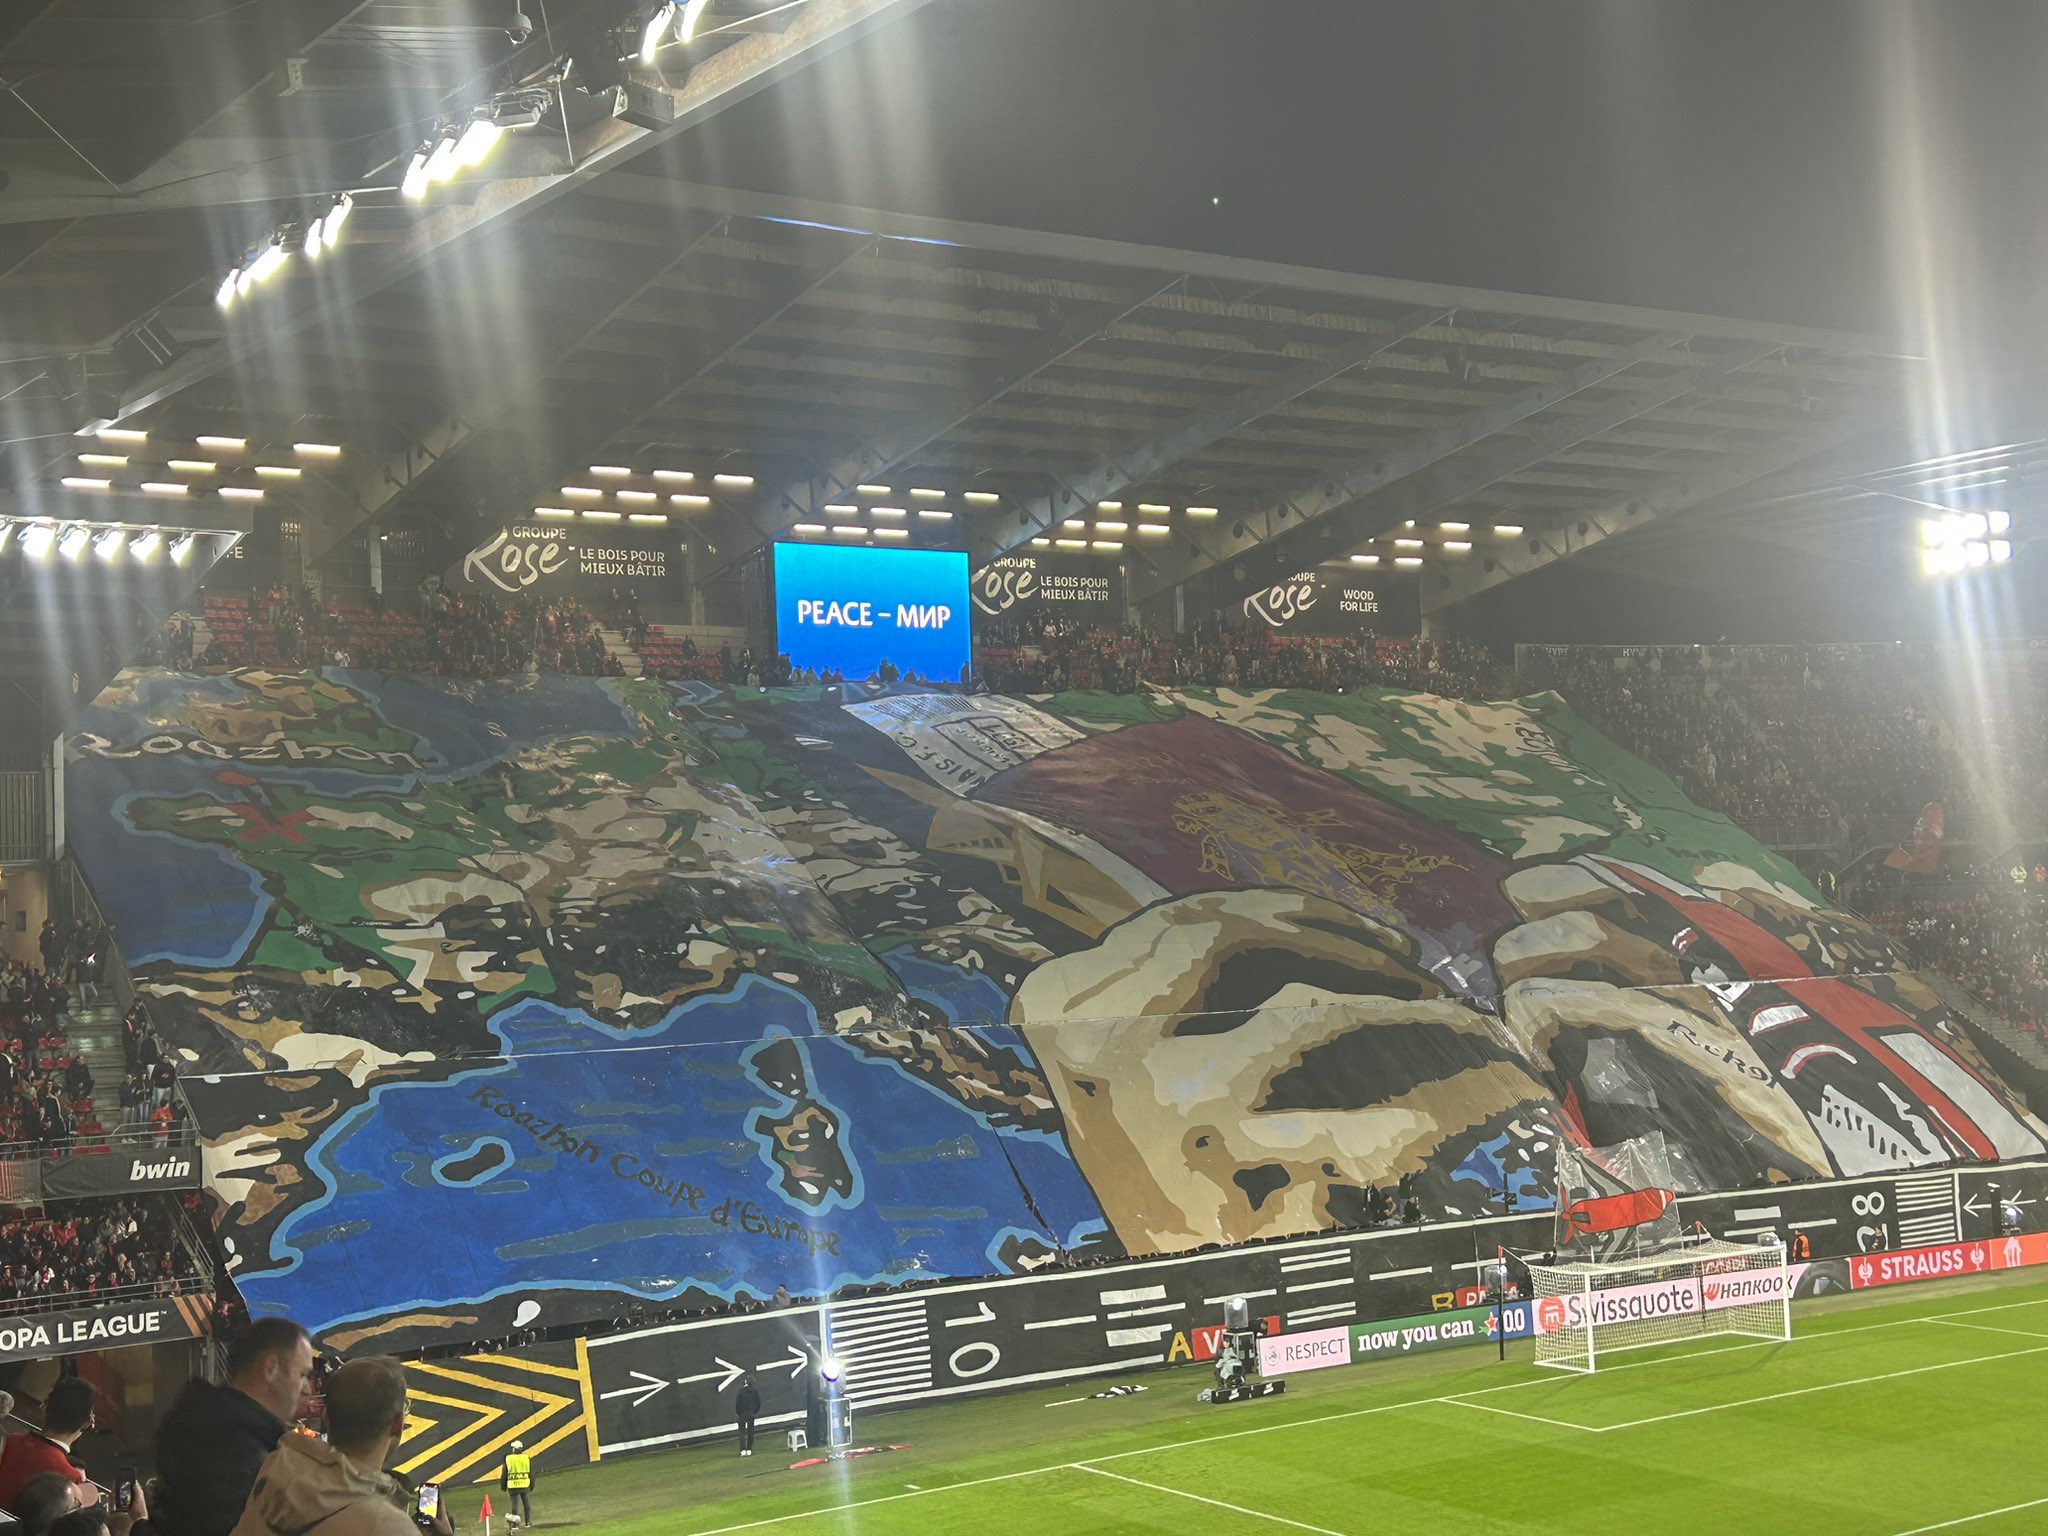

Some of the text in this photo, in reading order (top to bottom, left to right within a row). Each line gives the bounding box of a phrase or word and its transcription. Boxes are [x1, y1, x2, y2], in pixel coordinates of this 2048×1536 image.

[512, 526, 567, 540] GROUPE
[579, 548, 665, 563] LE BOIS POUR
[580, 562, 666, 577] MIEUX BÂTIR
[1040, 576, 1109, 588] LE BOIS POUR
[1041, 588, 1109, 601] MIEUX BÂTIR
[1343, 589, 1374, 600] WOOD
[797, 599, 874, 626] PEACE
[896, 603, 951, 629] МИР
[1340, 601, 1378, 613] FOR LIFE
[129, 1156, 191, 1181] bwin
[466, 1083, 842, 1258] Roazhon Coupe d'Europe
[1881, 1248, 1964, 1280] STRAUSS
[0, 1325, 50, 1351] OPA
[1358, 1319, 1475, 1352] now you can
[1285, 1337, 1346, 1362] RESPECT
